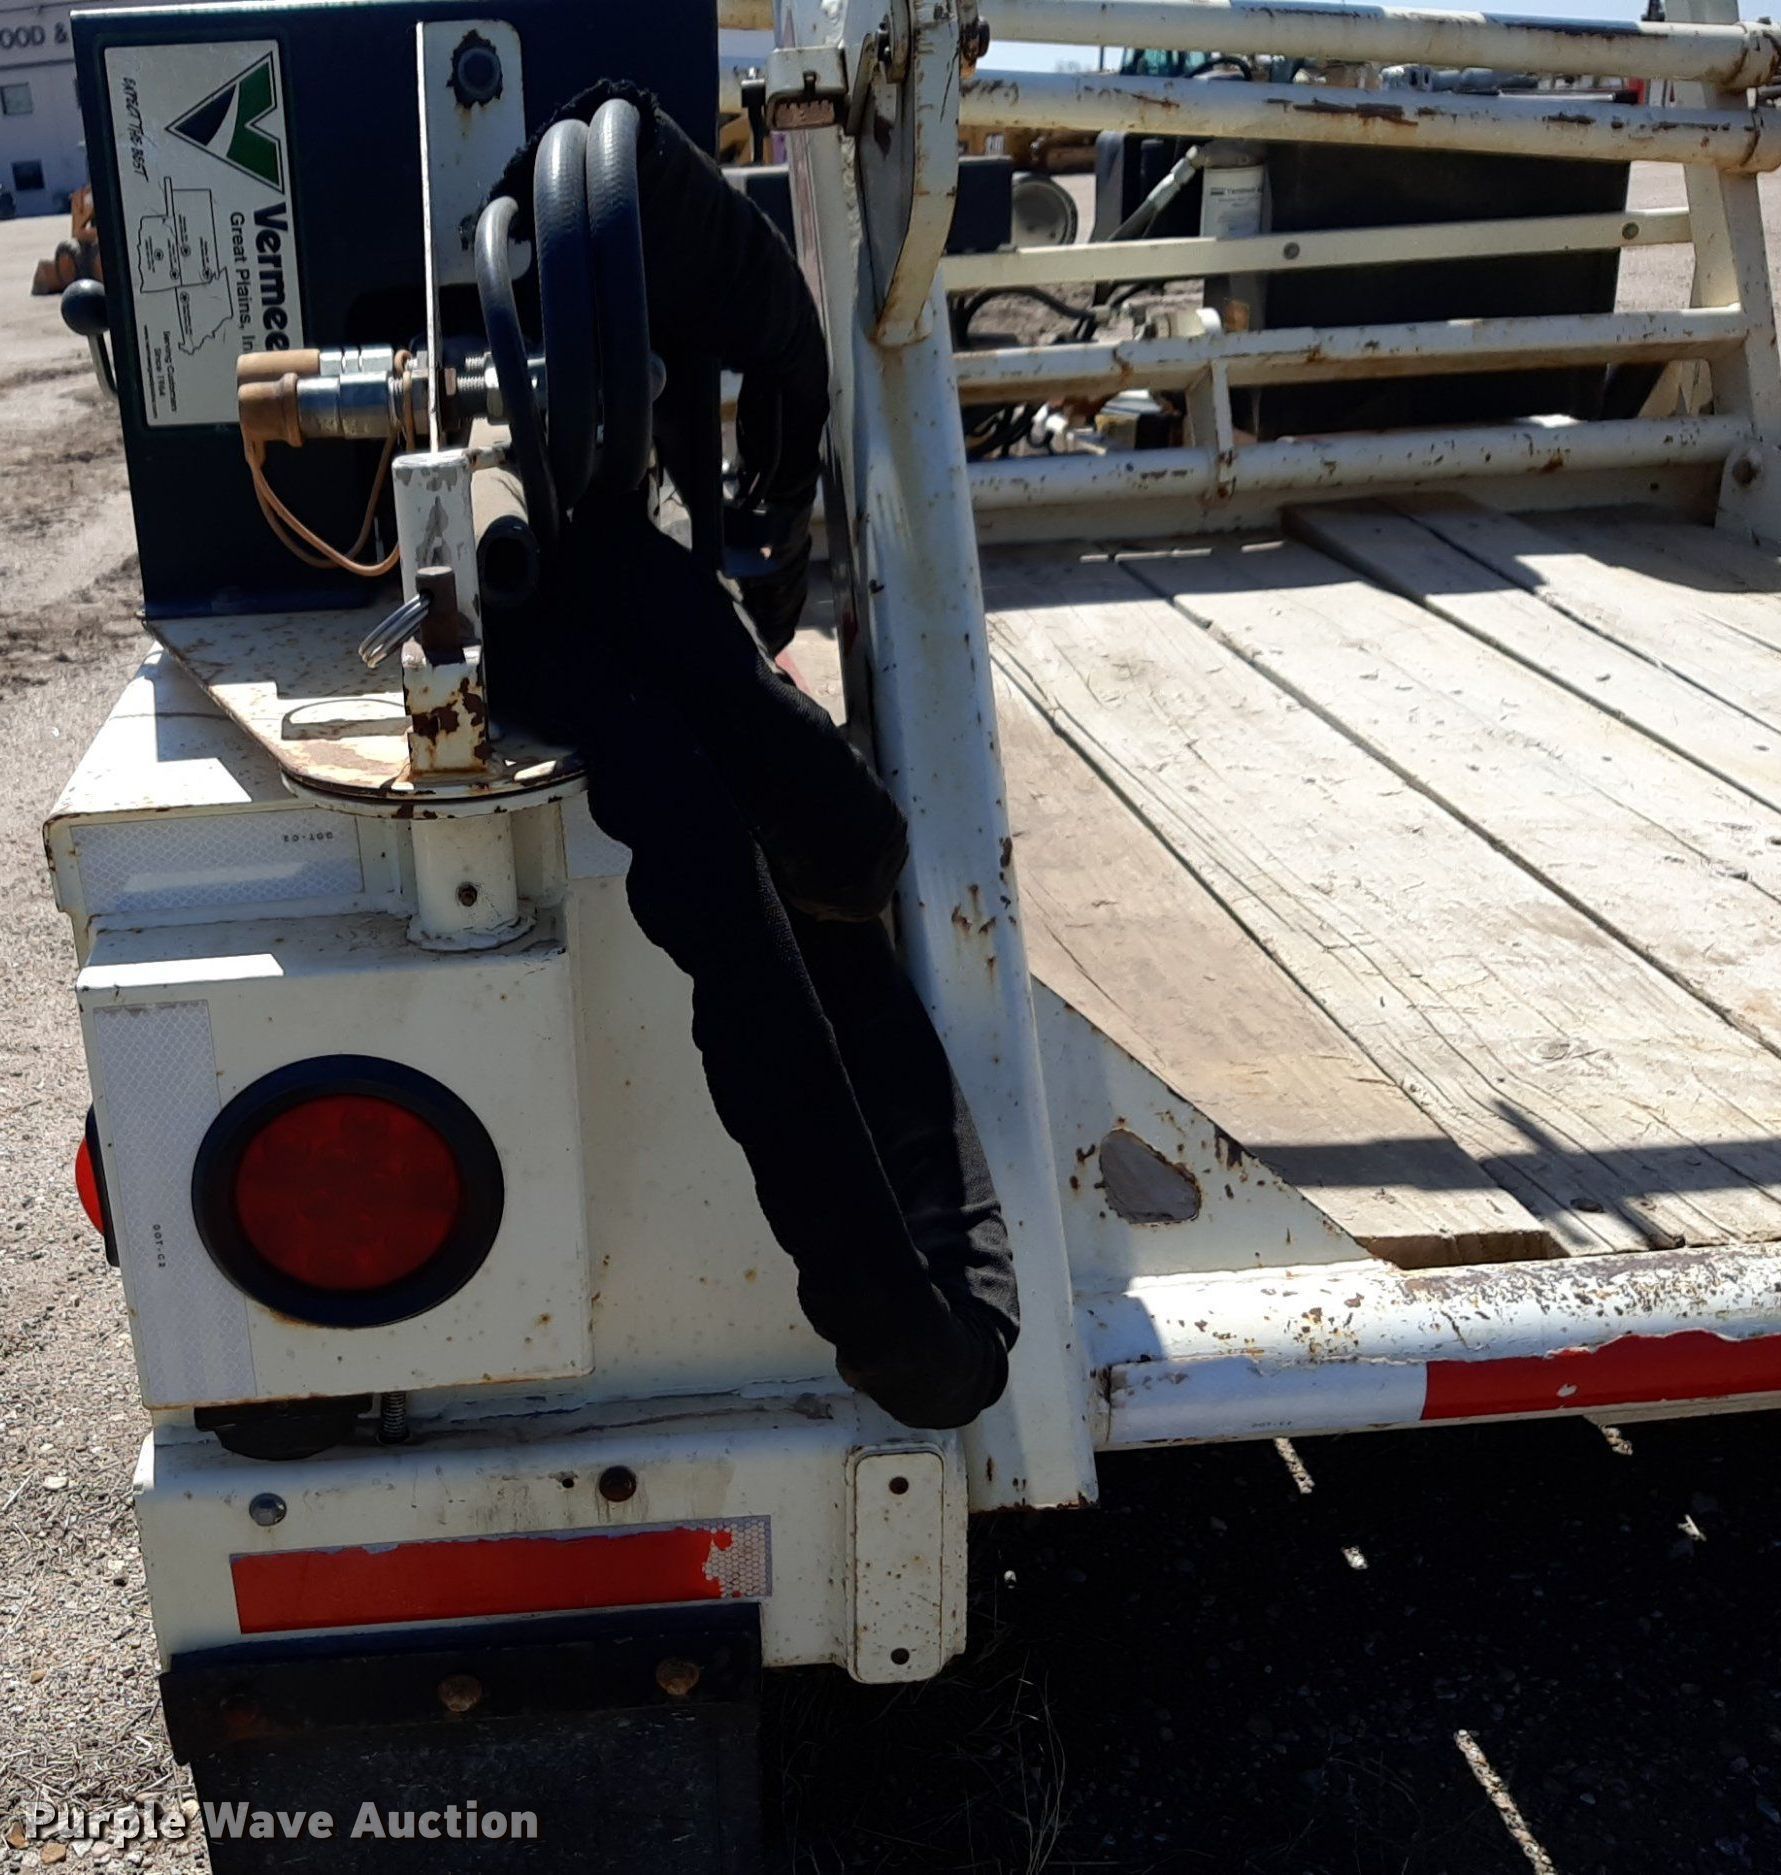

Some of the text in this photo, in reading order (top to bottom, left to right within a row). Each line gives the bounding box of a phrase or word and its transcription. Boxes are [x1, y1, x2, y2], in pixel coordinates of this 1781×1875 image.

[230, 211, 256, 354] Great Plains, In
[253, 201, 290, 351] Vermee
